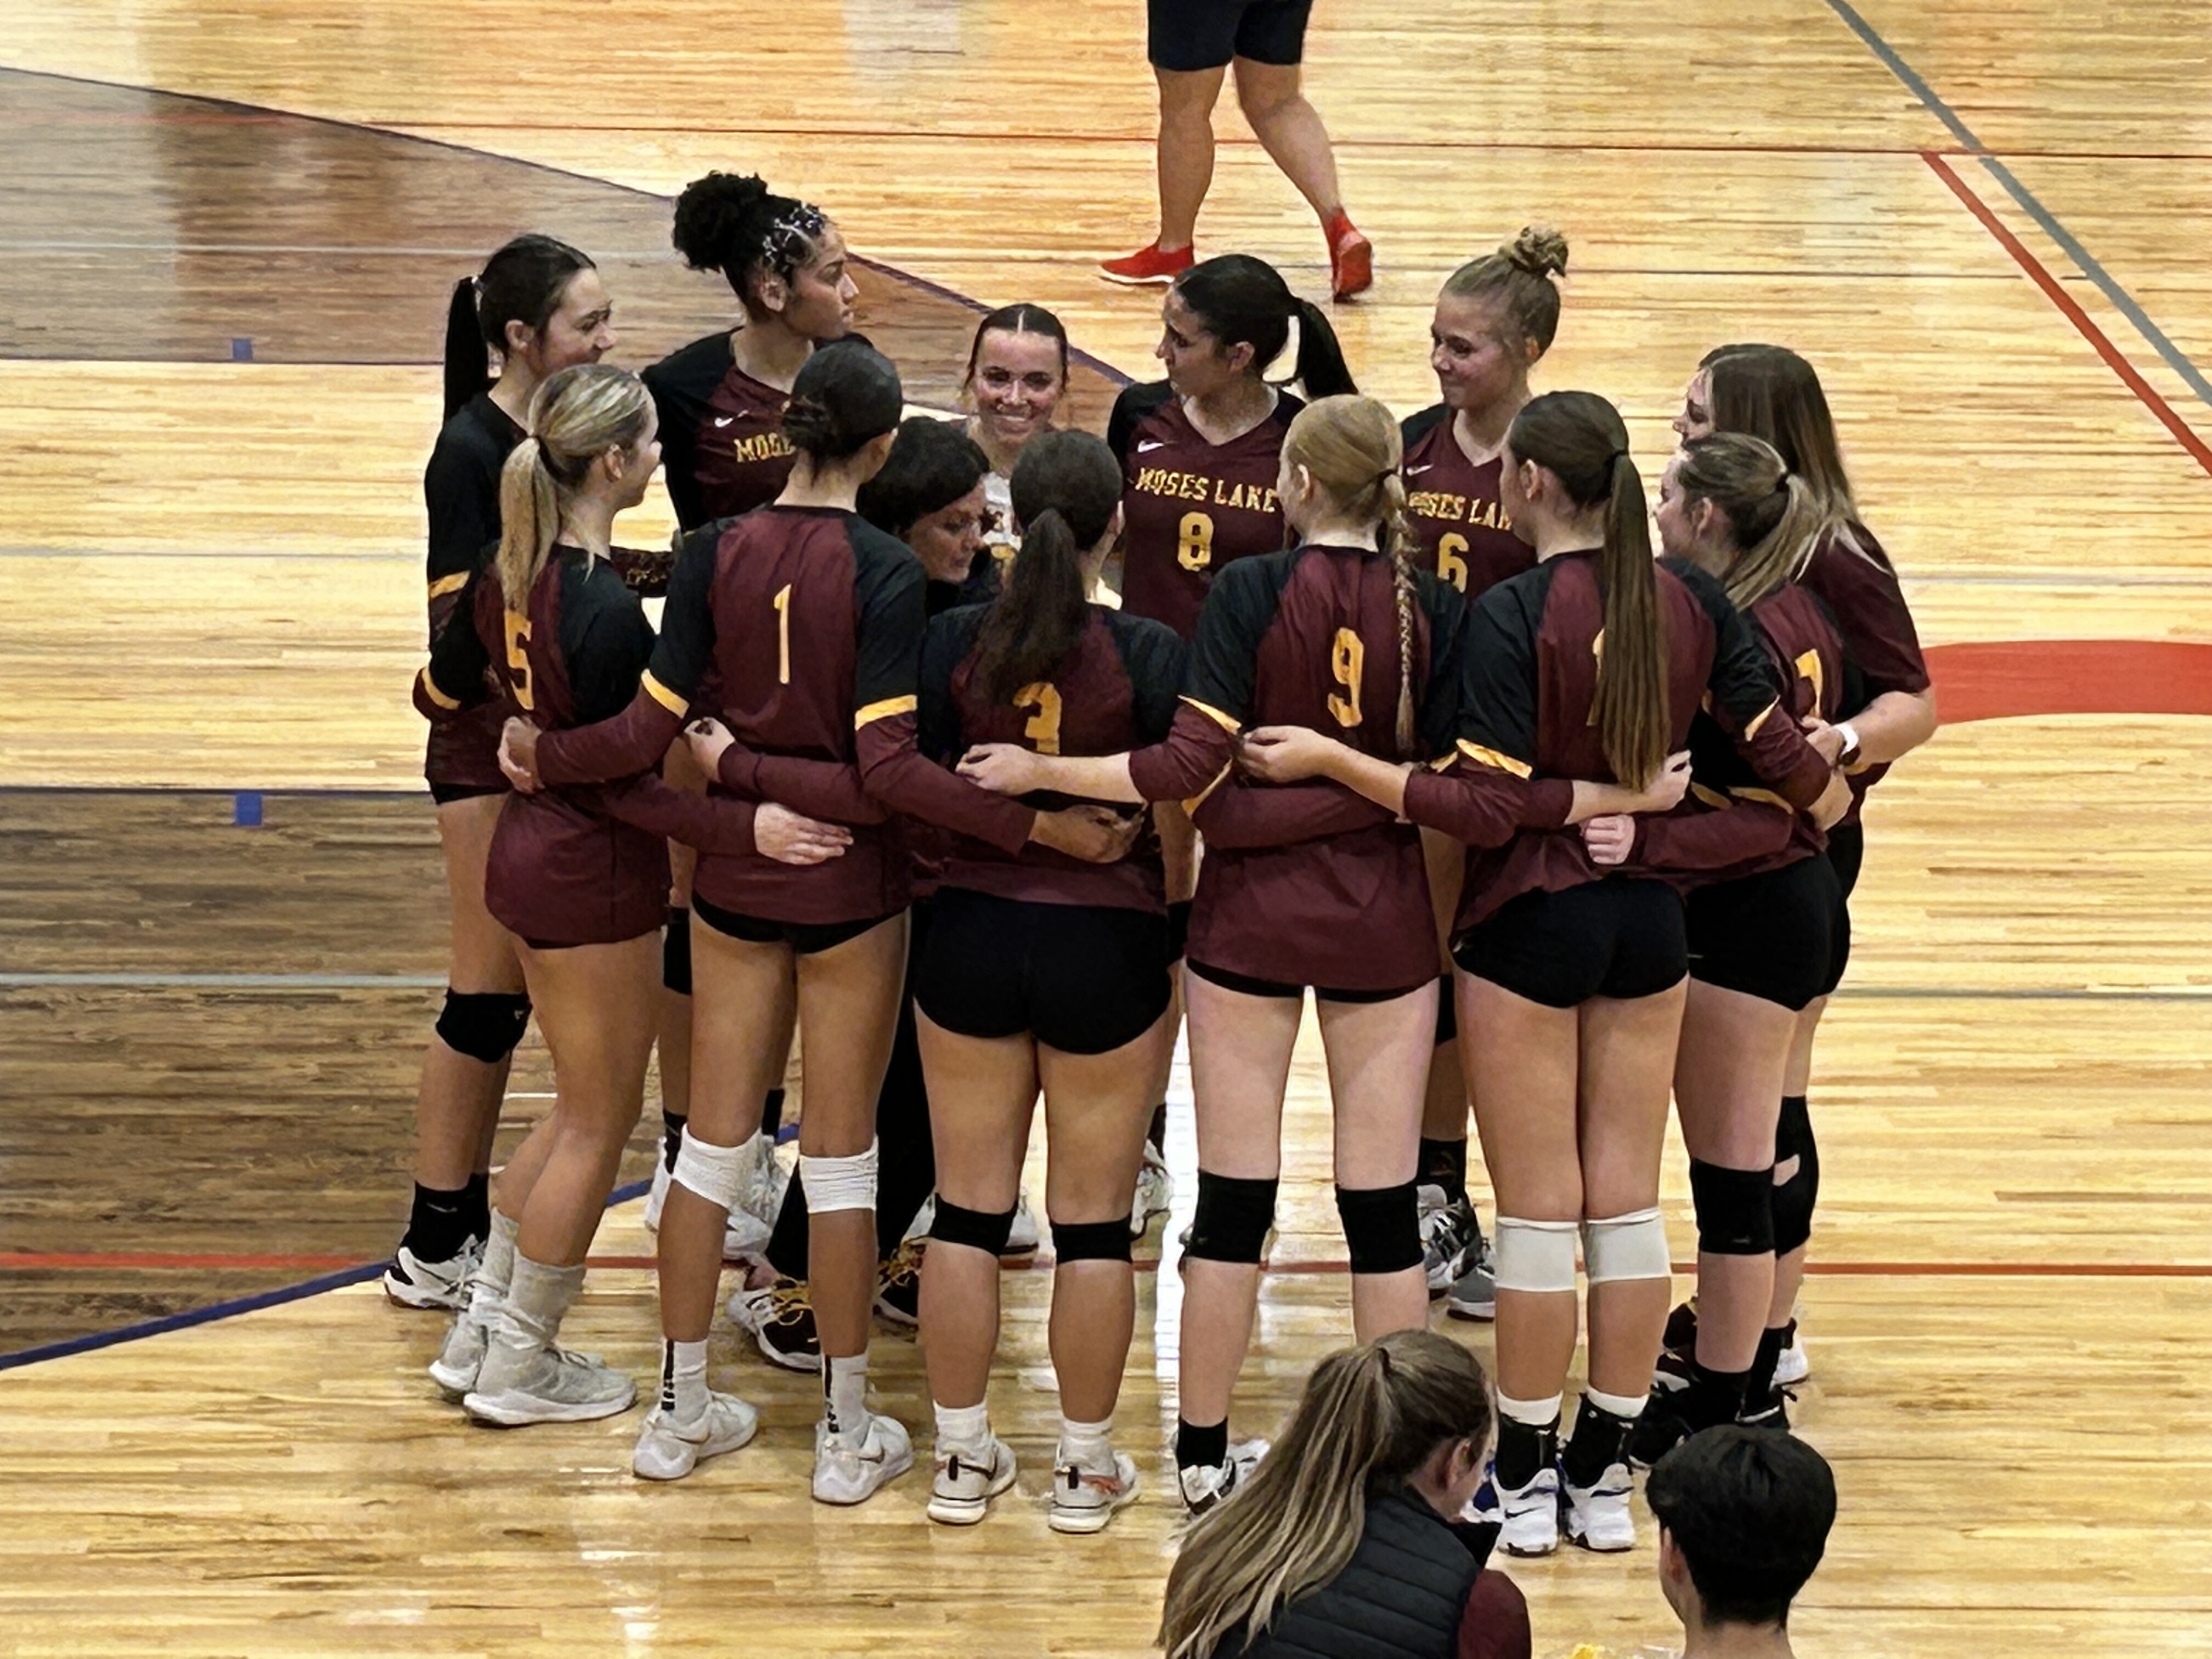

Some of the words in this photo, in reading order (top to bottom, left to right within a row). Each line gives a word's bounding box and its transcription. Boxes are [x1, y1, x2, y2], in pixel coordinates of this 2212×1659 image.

[1135, 467, 1209, 501] MOSES
[1214, 479, 1278, 513] LAKE
[1177, 511, 1214, 572] 8
[1437, 532, 1470, 593] 6
[504, 609, 535, 710] 5
[774, 584, 792, 685] 1
[1328, 627, 1364, 727] 9
